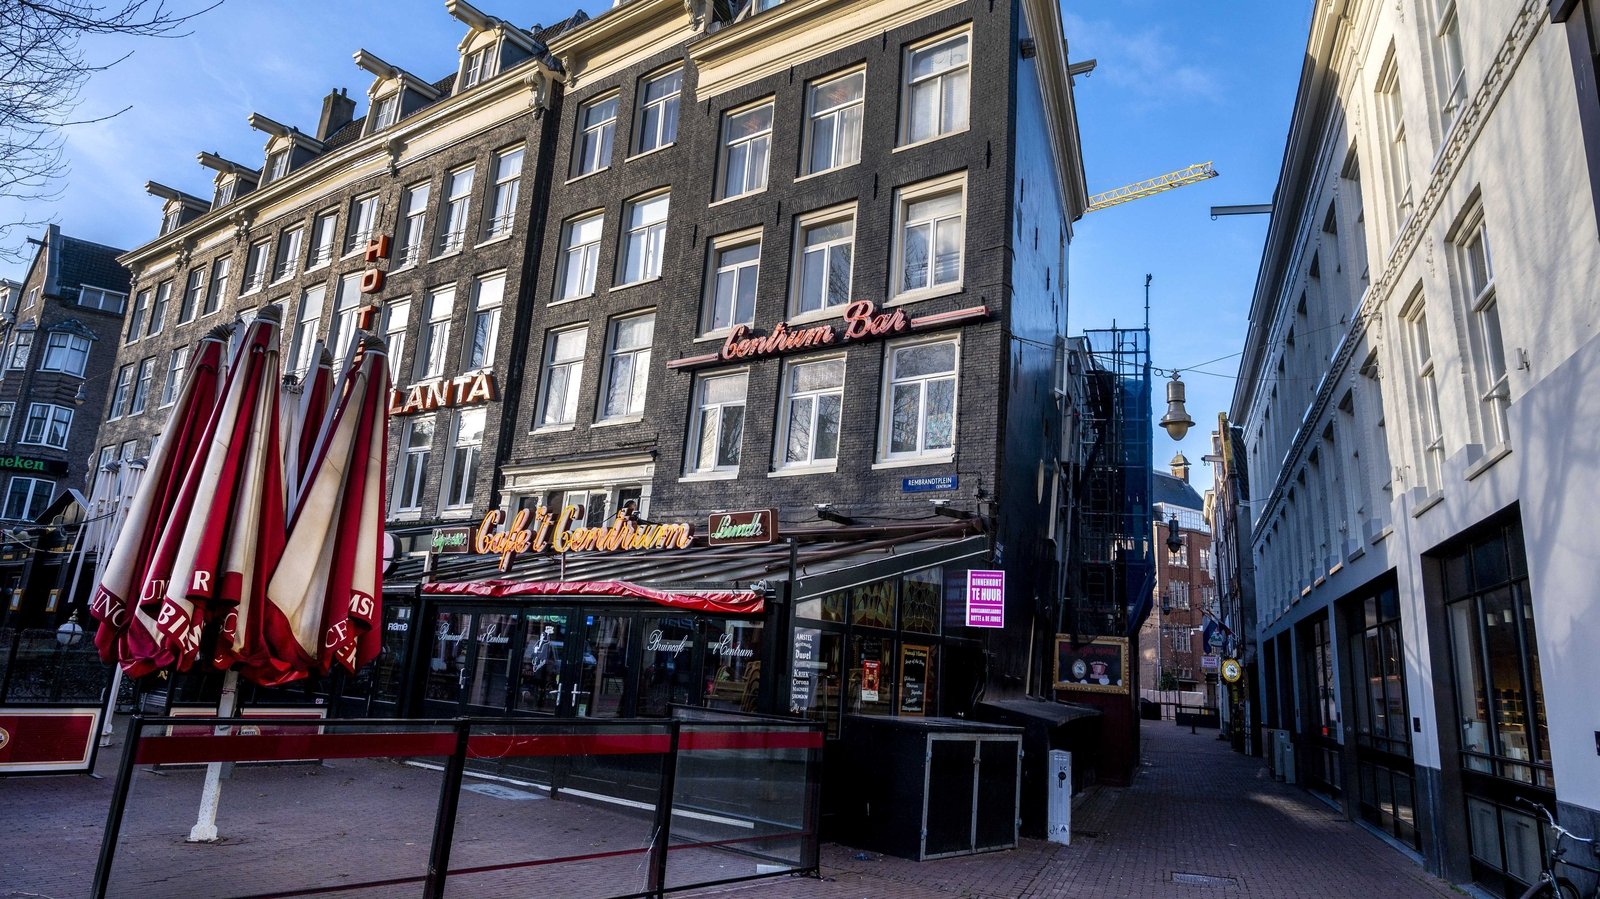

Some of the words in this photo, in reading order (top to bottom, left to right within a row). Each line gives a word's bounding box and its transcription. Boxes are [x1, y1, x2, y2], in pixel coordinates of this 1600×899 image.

[722, 322, 835, 360] Centrum
[843, 299, 907, 340] Bar
[908, 477, 952, 486] REMBRANDTPLEIN
[552, 504, 694, 553] Centrum
[971, 588, 980, 601] TE
[981, 588, 1002, 602] HUUR
[795, 633, 813, 642] AMSTEL
[795, 649, 812, 660] Duvel
[792, 678, 810, 686] Corona
